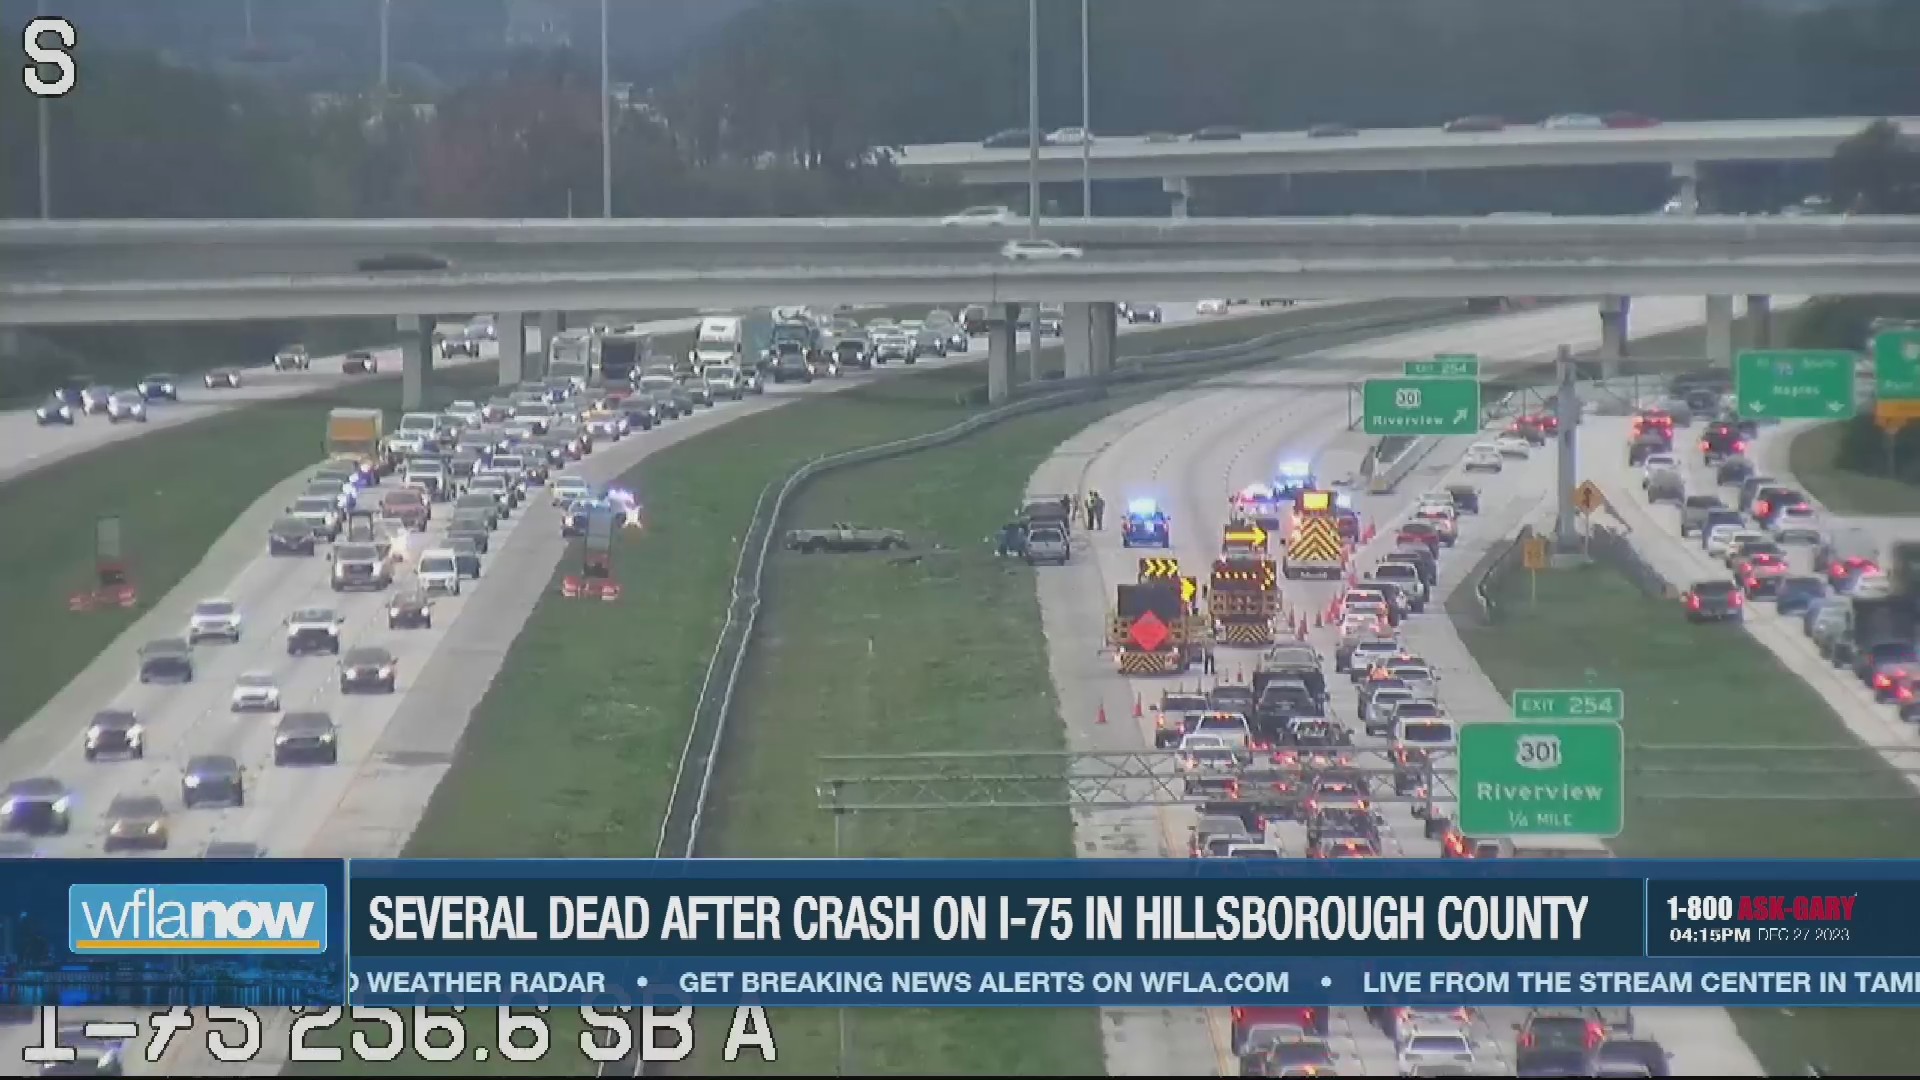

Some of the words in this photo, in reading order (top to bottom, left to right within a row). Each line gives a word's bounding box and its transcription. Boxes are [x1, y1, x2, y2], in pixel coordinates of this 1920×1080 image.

[1522, 698, 1554, 711] EXIT
[1569, 697, 1613, 714] 254
[1521, 741, 1557, 762] 301
[1477, 782, 1602, 801] Riverview
[1537, 813, 1573, 827] MILE
